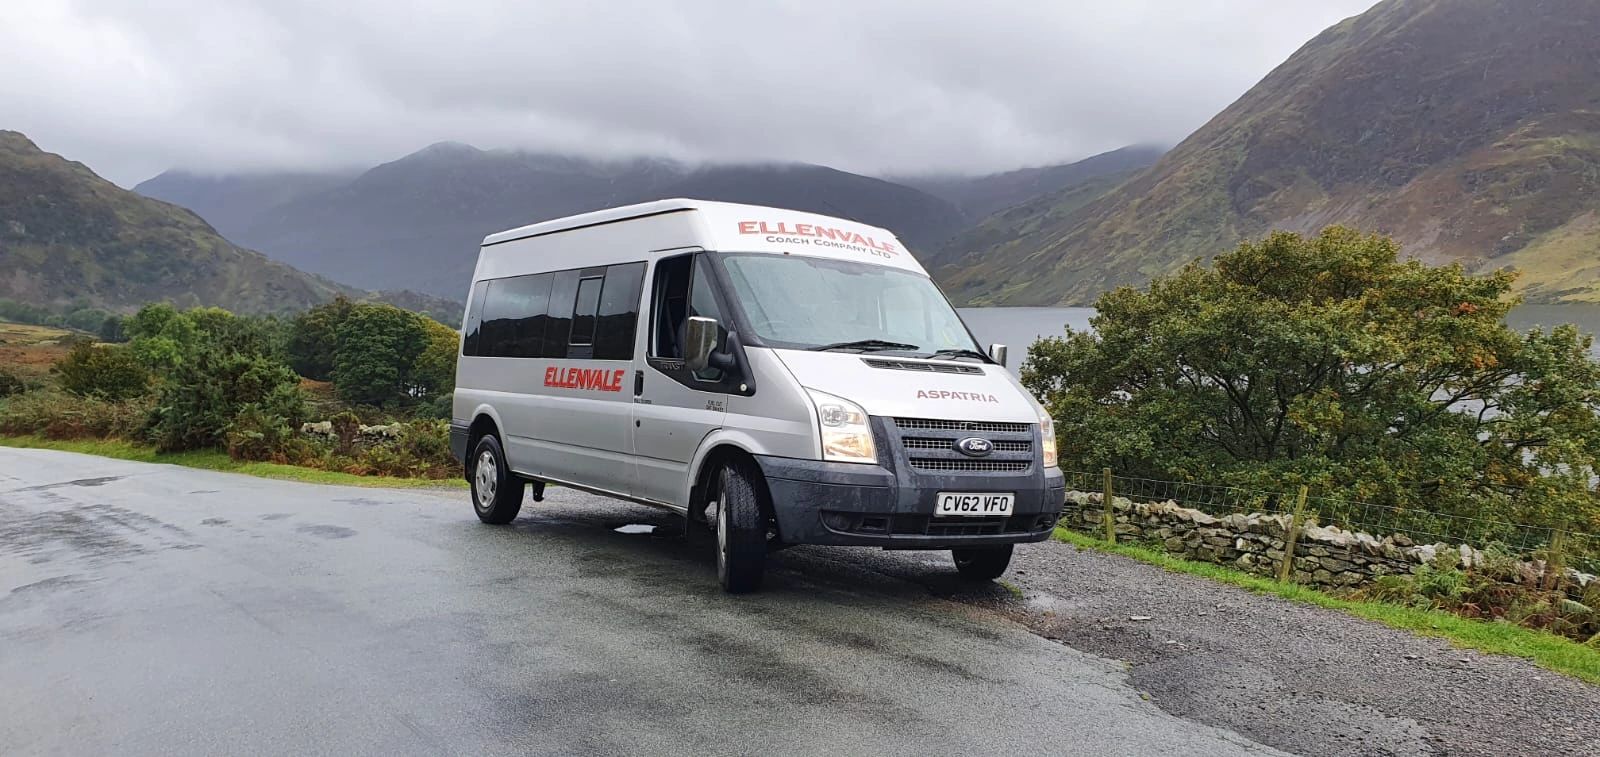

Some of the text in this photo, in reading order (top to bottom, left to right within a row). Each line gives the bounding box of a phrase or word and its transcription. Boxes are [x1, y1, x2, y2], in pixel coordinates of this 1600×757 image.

[738, 221, 899, 255] ELLENVALE
[766, 235, 809, 245] COACH
[814, 239, 866, 253] COMPANY
[543, 367, 624, 392] ELLENVALE
[917, 390, 999, 404] ASPATRIA
[968, 440, 988, 450] Ford
[943, 496, 980, 511] CV62
